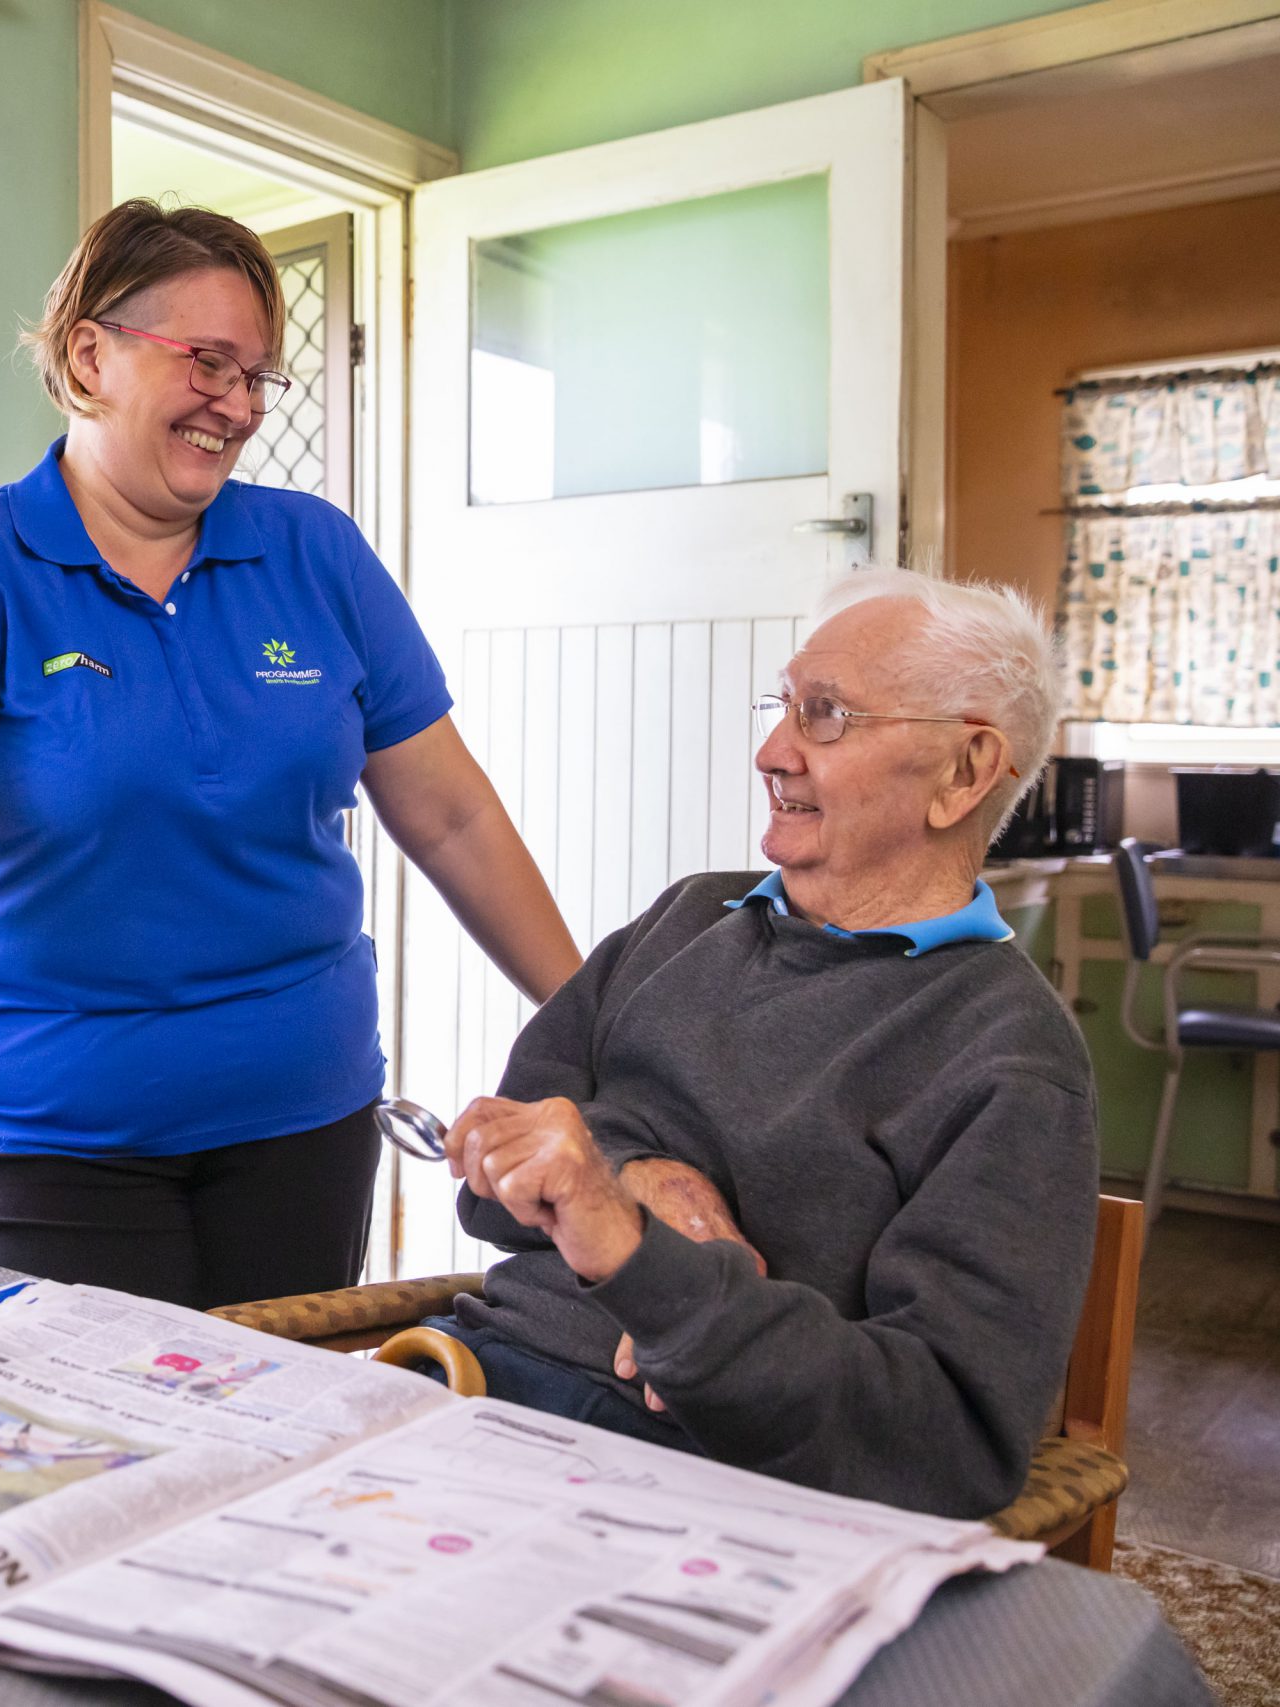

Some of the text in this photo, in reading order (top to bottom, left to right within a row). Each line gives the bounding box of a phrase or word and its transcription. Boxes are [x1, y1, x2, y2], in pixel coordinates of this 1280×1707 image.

[44, 653, 110, 676] zero harm
[255, 669, 321, 678] PROGRAMMED
